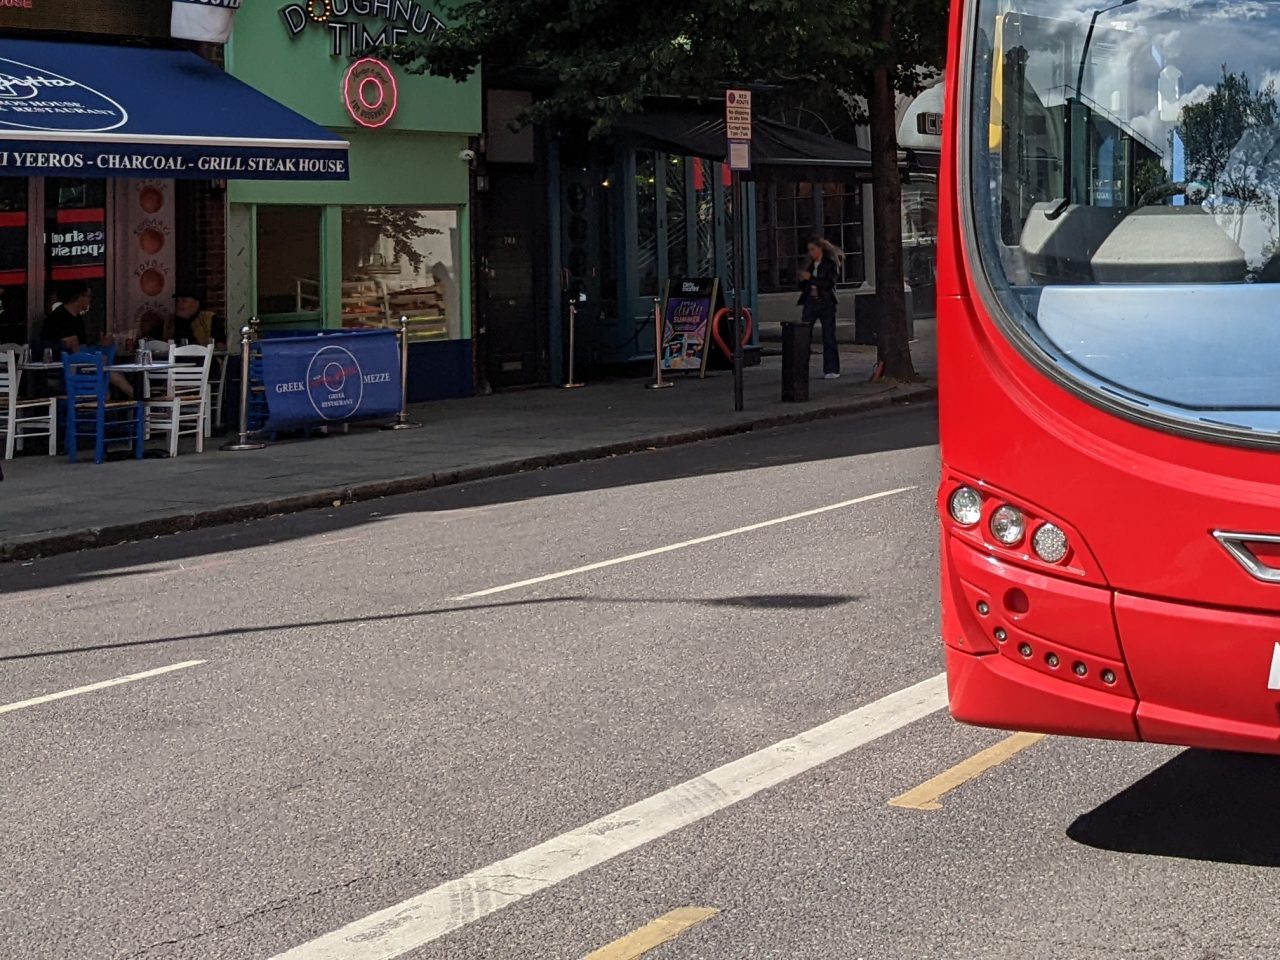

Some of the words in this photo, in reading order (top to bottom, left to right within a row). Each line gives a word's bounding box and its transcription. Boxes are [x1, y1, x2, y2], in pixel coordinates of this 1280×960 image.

[13, 152, 84, 168] YEEROS
[97, 154, 186, 170] CHARCOAL
[198, 156, 245, 171] GRILL
[247, 157, 296, 172] STEAK
[298, 158, 346, 173] HOUSE
[363, 372, 391, 384] MEZZE
[275, 381, 305, 393] GREEK
